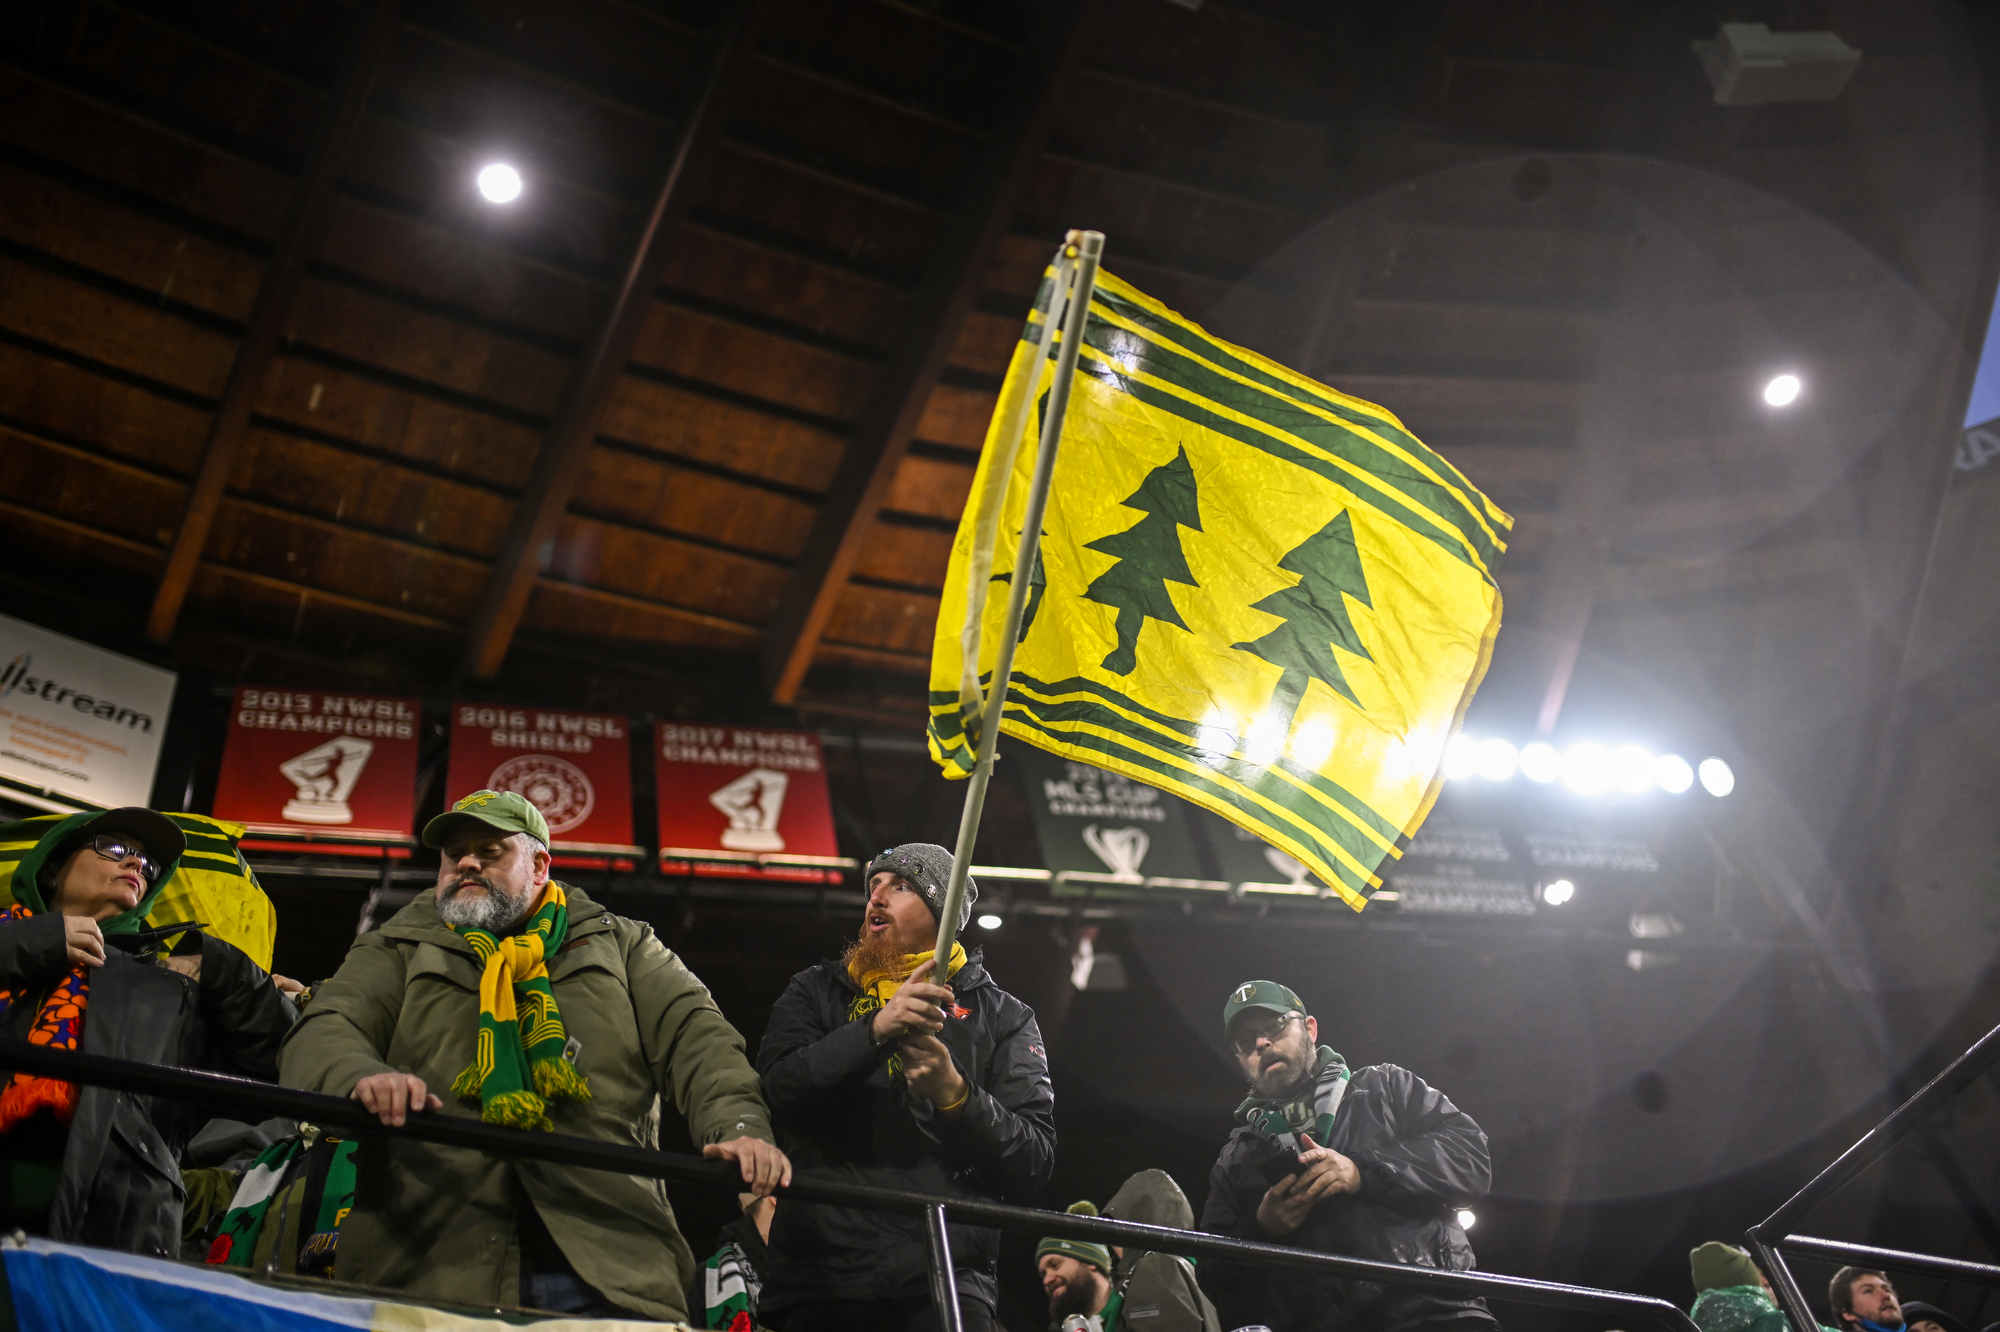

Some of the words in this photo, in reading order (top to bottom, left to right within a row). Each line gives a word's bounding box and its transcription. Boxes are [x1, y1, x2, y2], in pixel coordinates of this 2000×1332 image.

[0, 652, 152, 733] llstream
[241, 689, 312, 713] 2013
[322, 696, 414, 721] NWSL
[238, 709, 414, 739] CHAMPIONS
[460, 706, 527, 729] 2016
[536, 712, 623, 738] NWSL
[491, 728, 593, 753] SHIELD
[662, 724, 725, 746] 2017
[733, 730, 818, 754] NWSL
[662, 742, 820, 772] CHAMPIONS
[1043, 779, 1102, 801] MLS
[1105, 784, 1160, 804] CUP
[1049, 801, 1166, 822] CHAMPIONS
[1235, 984, 1252, 1002] T
